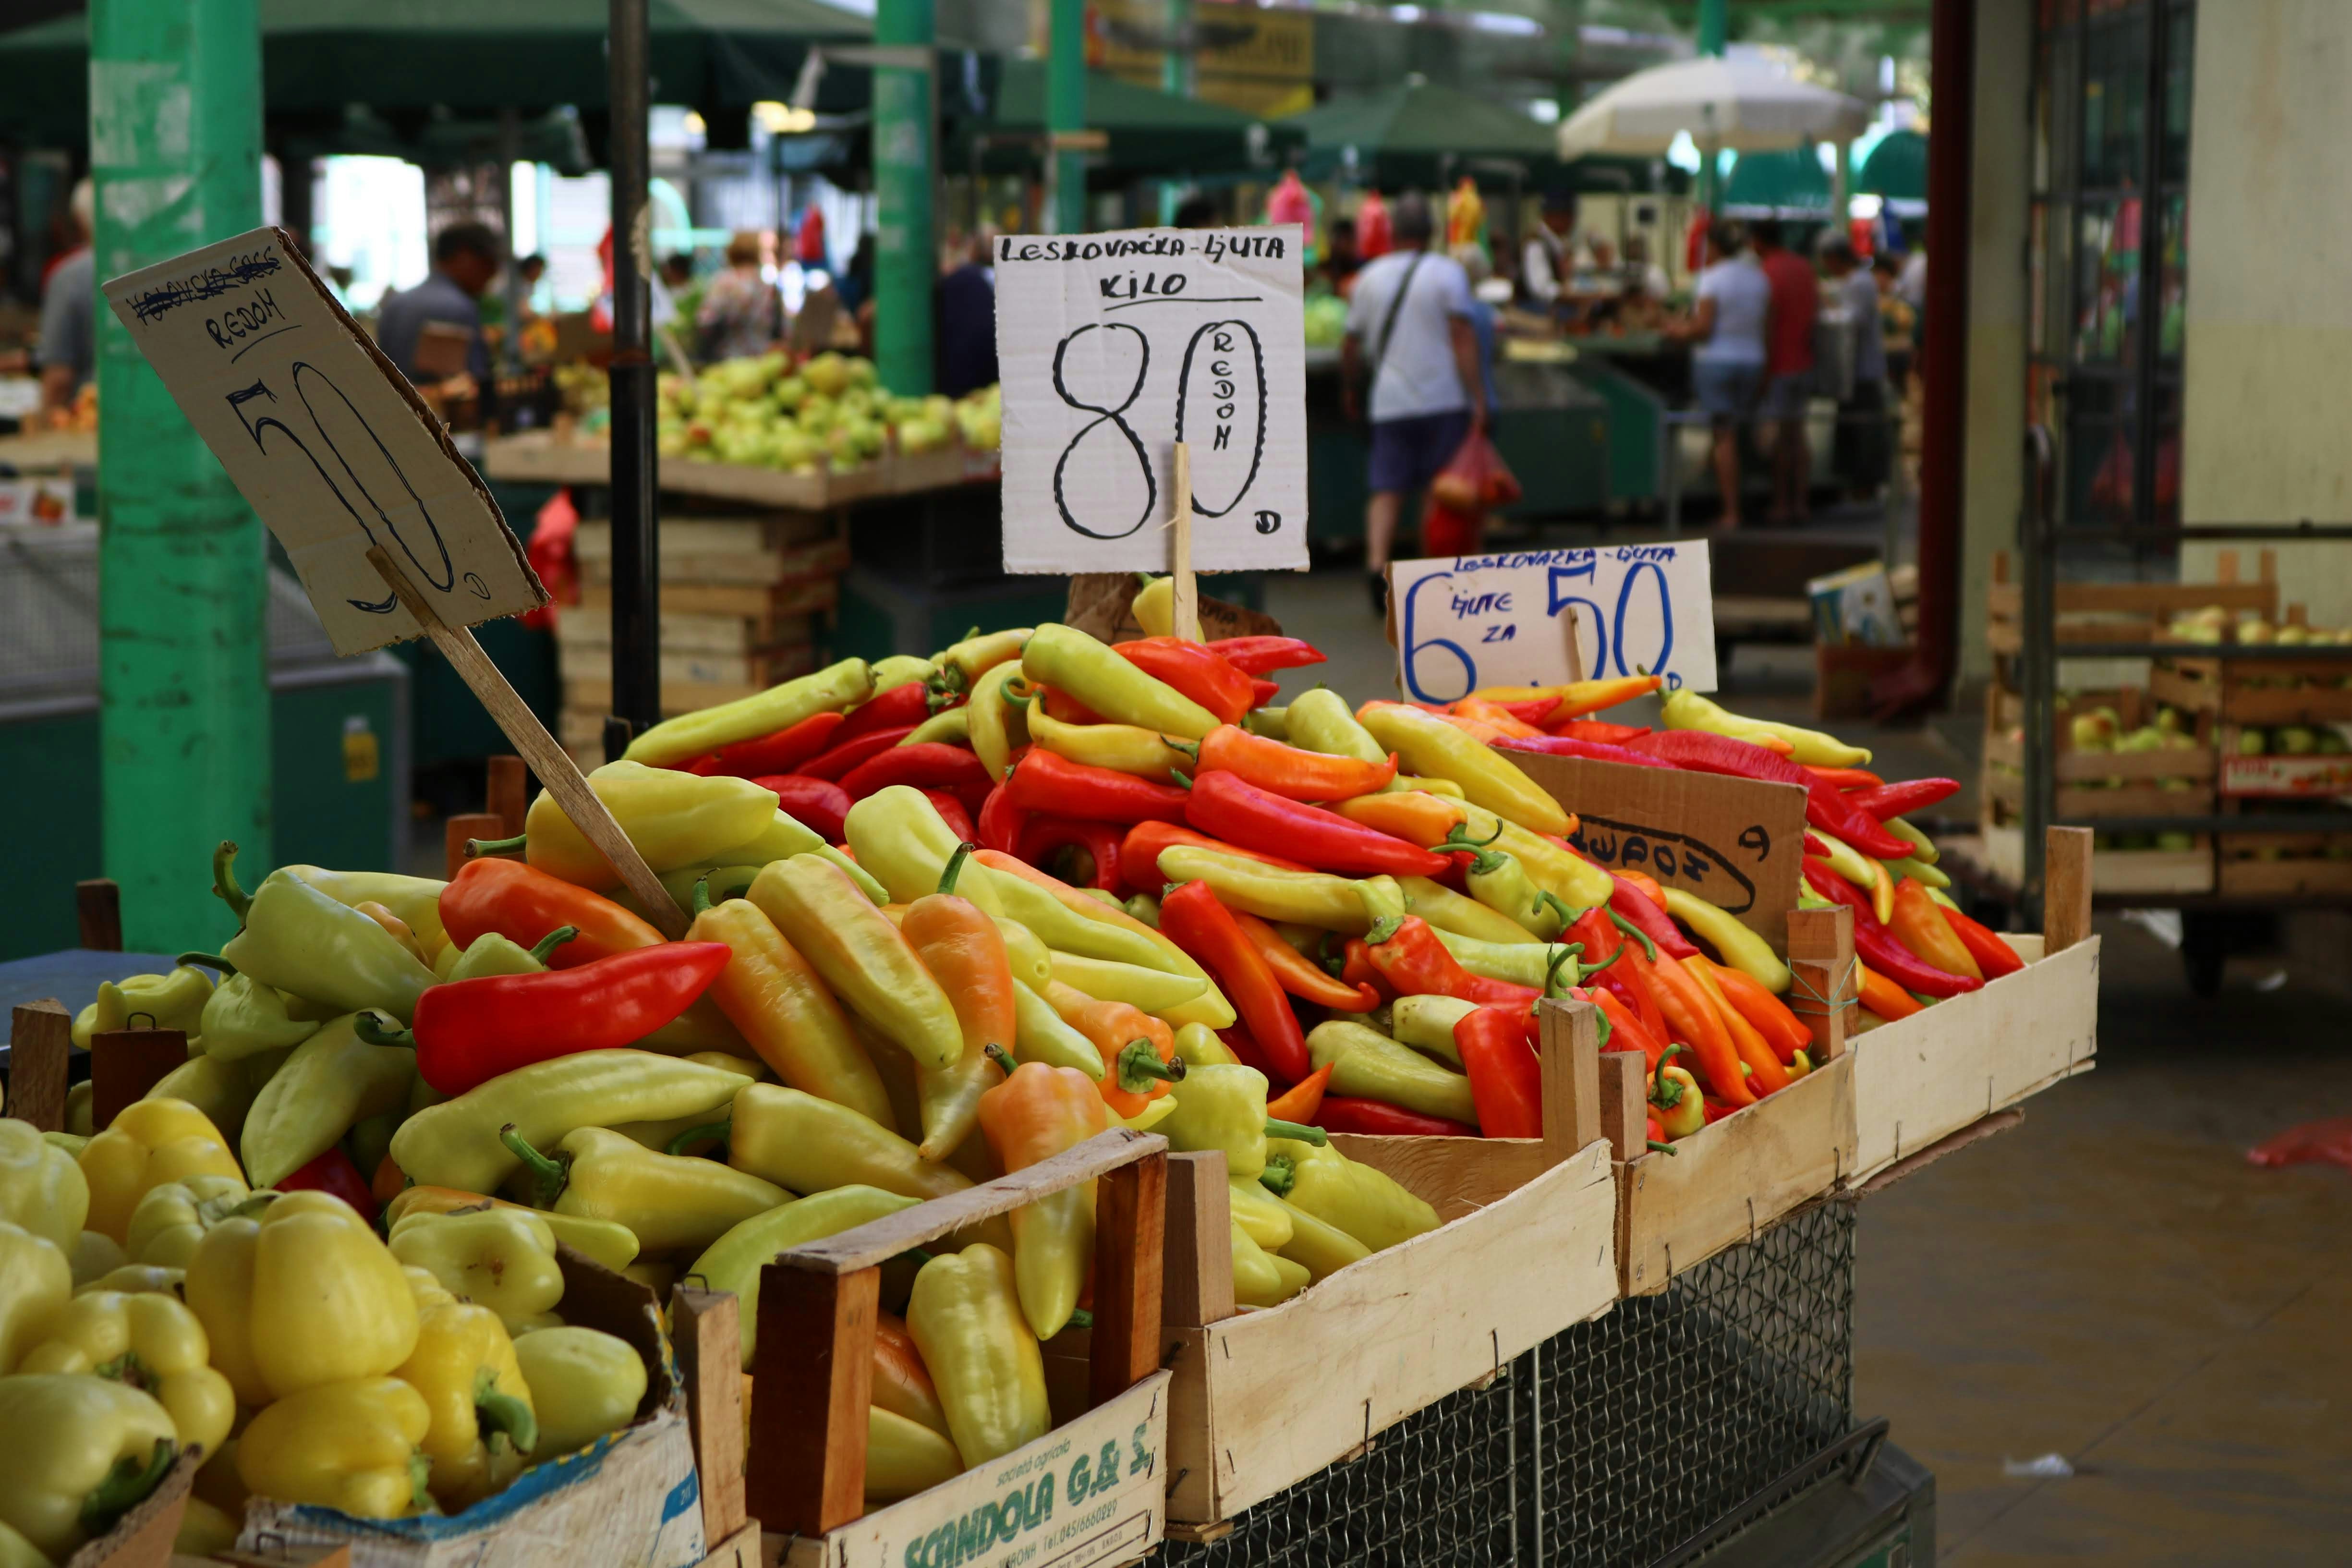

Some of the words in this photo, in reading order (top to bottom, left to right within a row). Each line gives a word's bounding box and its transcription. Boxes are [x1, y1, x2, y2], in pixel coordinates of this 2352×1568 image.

[205, 288, 286, 349] REDOM
[1052, 319, 1268, 540] 80
[1404, 571, 1478, 705] 6
[1481, 624, 1516, 643] ZA
